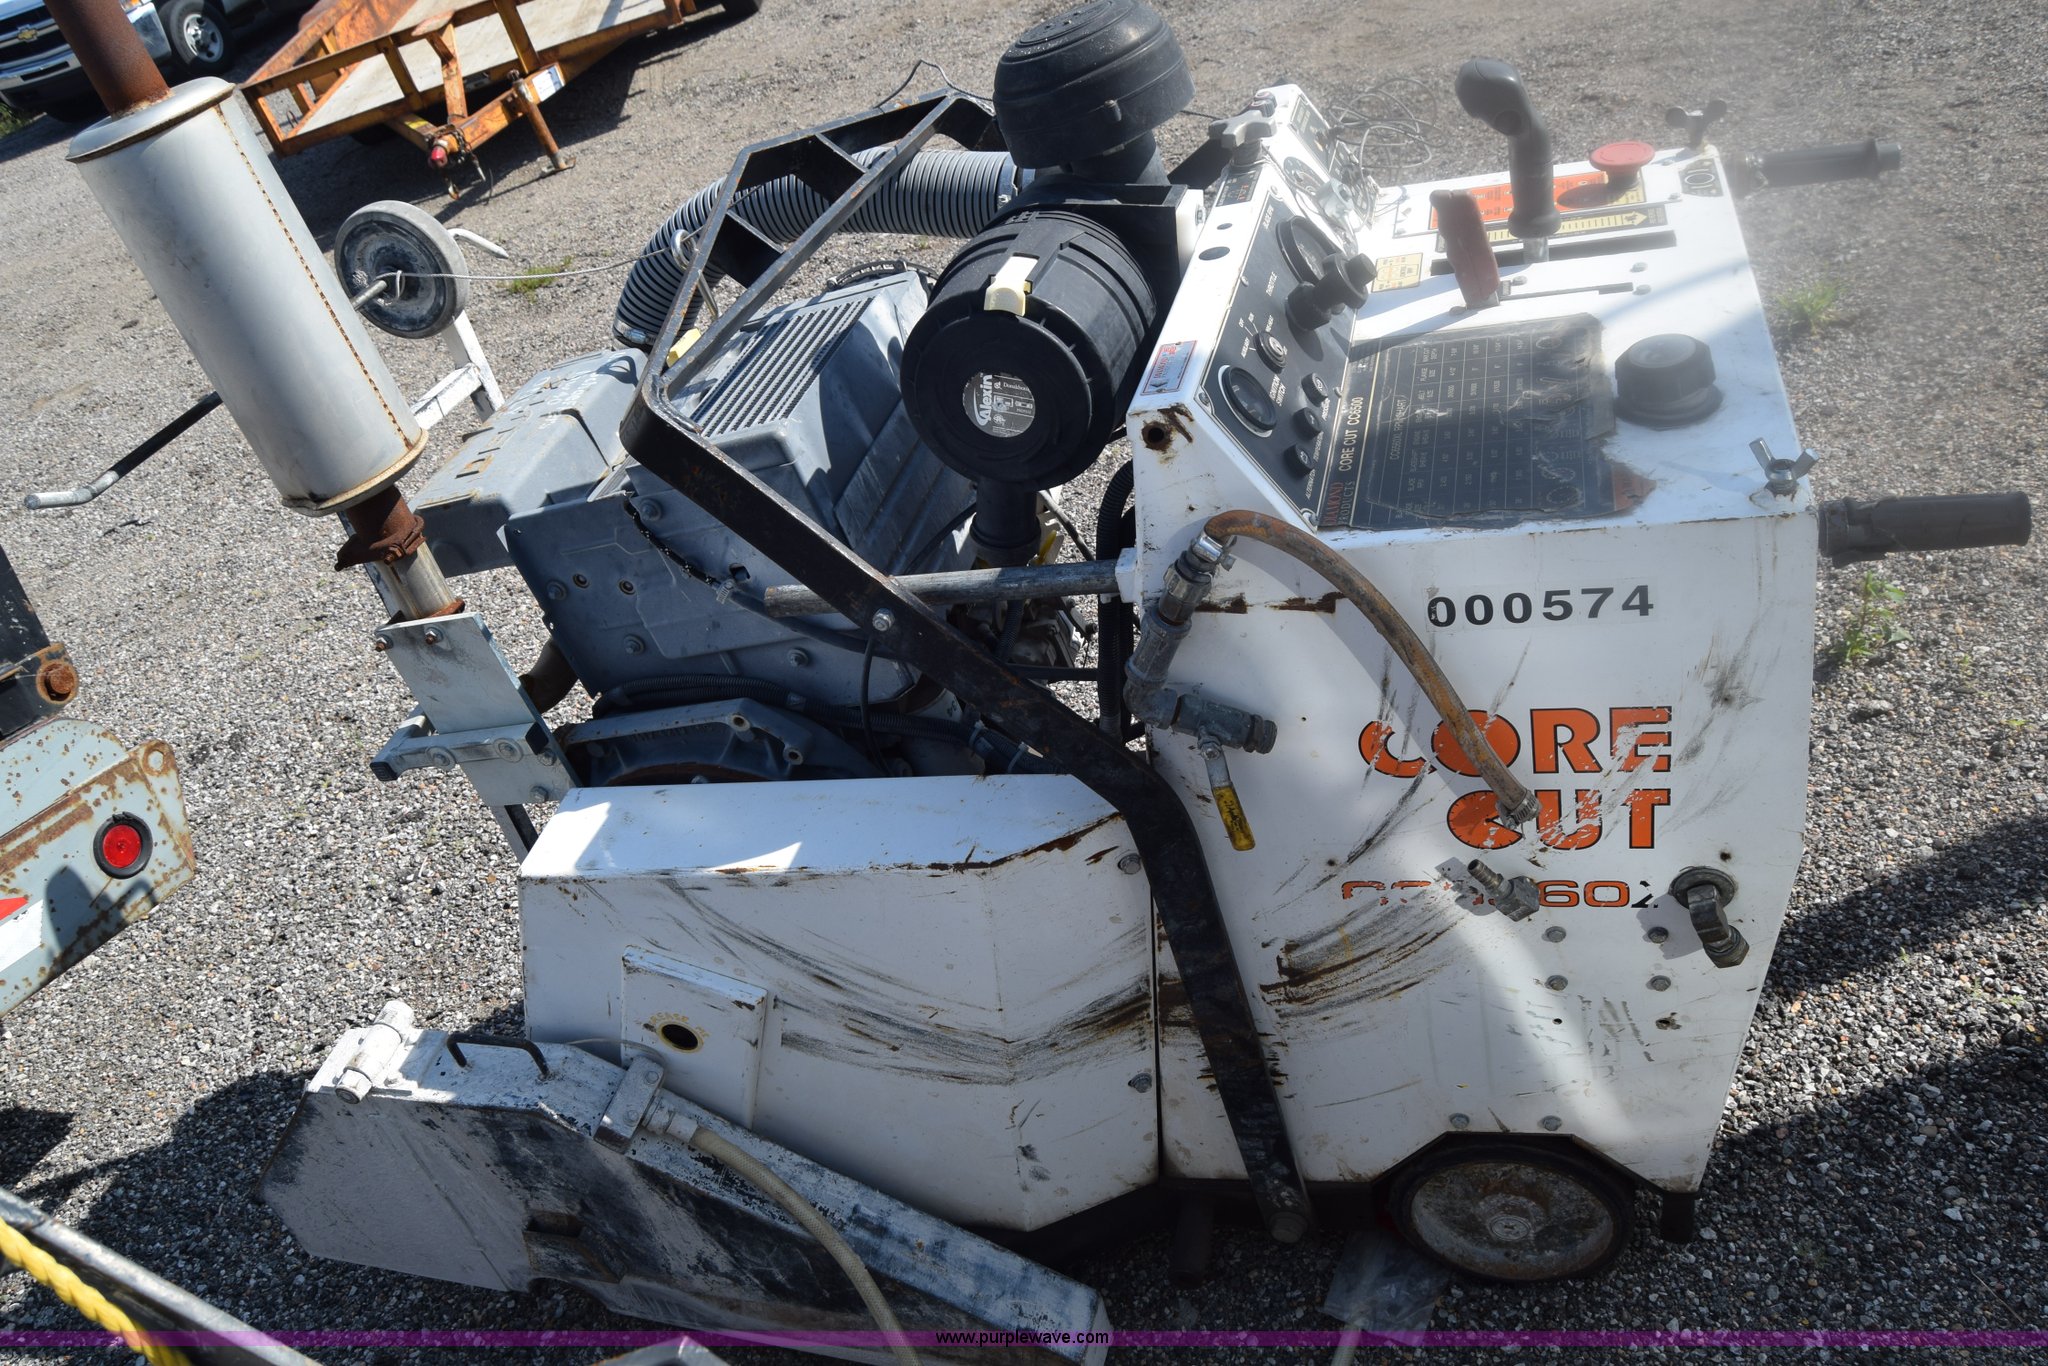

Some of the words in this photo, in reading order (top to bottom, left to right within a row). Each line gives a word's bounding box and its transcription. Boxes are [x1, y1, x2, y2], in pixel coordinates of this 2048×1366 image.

[977, 374, 992, 422] Alexin
[1268, 374, 1281, 401] IGNITION
[1275, 382, 1287, 407] SWITCH
[1346, 396, 1364, 426] CC6500
[1343, 429, 1358, 446] CUT
[1338, 446, 1355, 472] CORE
[1427, 584, 1654, 628] 000574
[1358, 706, 1672, 779] CORE
[1446, 788, 1671, 850] CUT
